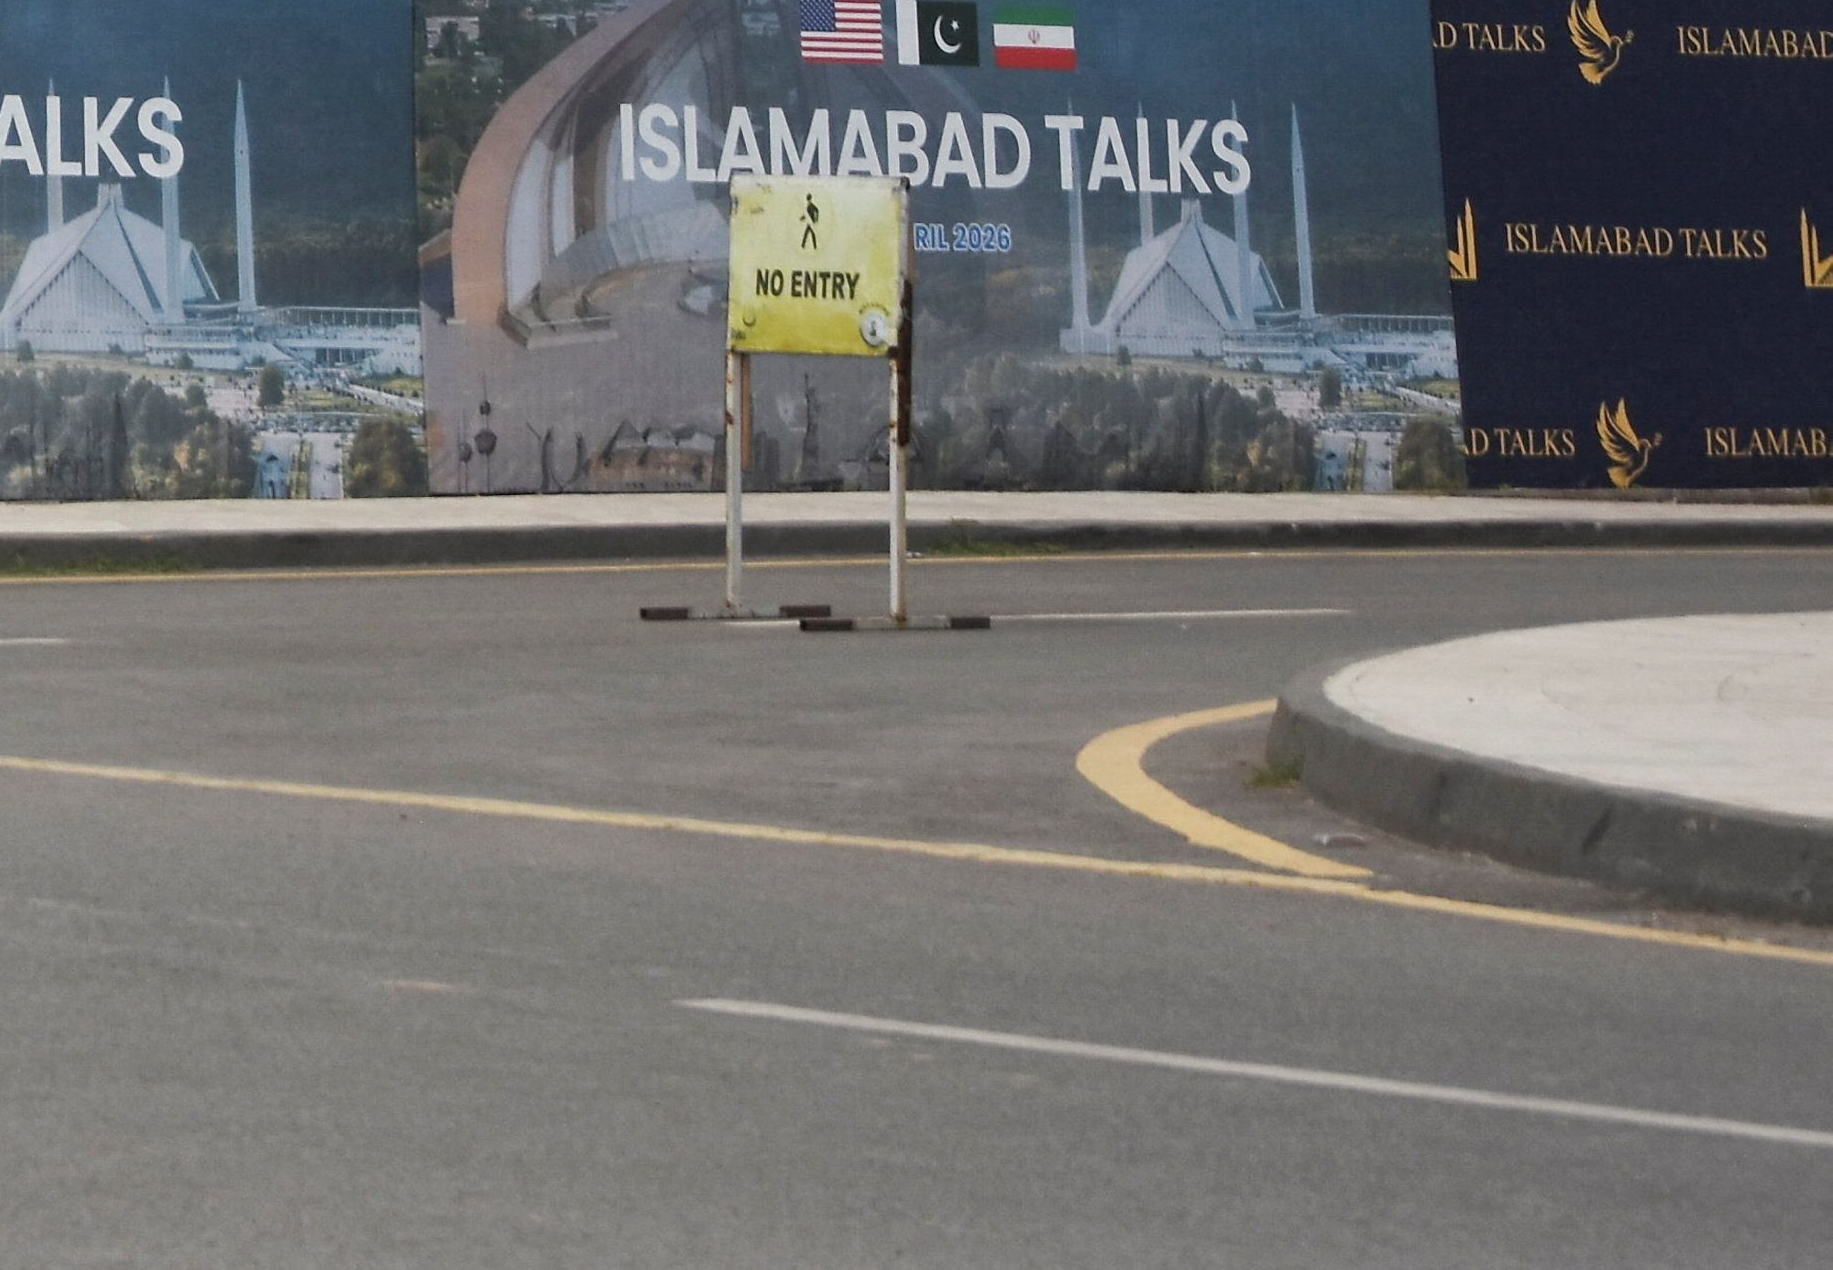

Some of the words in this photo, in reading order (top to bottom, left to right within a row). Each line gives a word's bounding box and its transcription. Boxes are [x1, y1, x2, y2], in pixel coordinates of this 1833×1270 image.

[1462, 23, 1546, 53] TALKS
[620, 101, 1032, 189] ISLAMABAD
[1044, 113, 1252, 195] TALKS
[952, 223, 1012, 252] 2026
[1505, 222, 1674, 257] ISLAMABAD
[1679, 227, 1768, 260] TALKS
[755, 268, 785, 298] NO
[790, 269, 861, 300] ENTRY
[1493, 427, 1576, 457] TALKS
[1704, 426, 1833, 458] ISLAMAB
